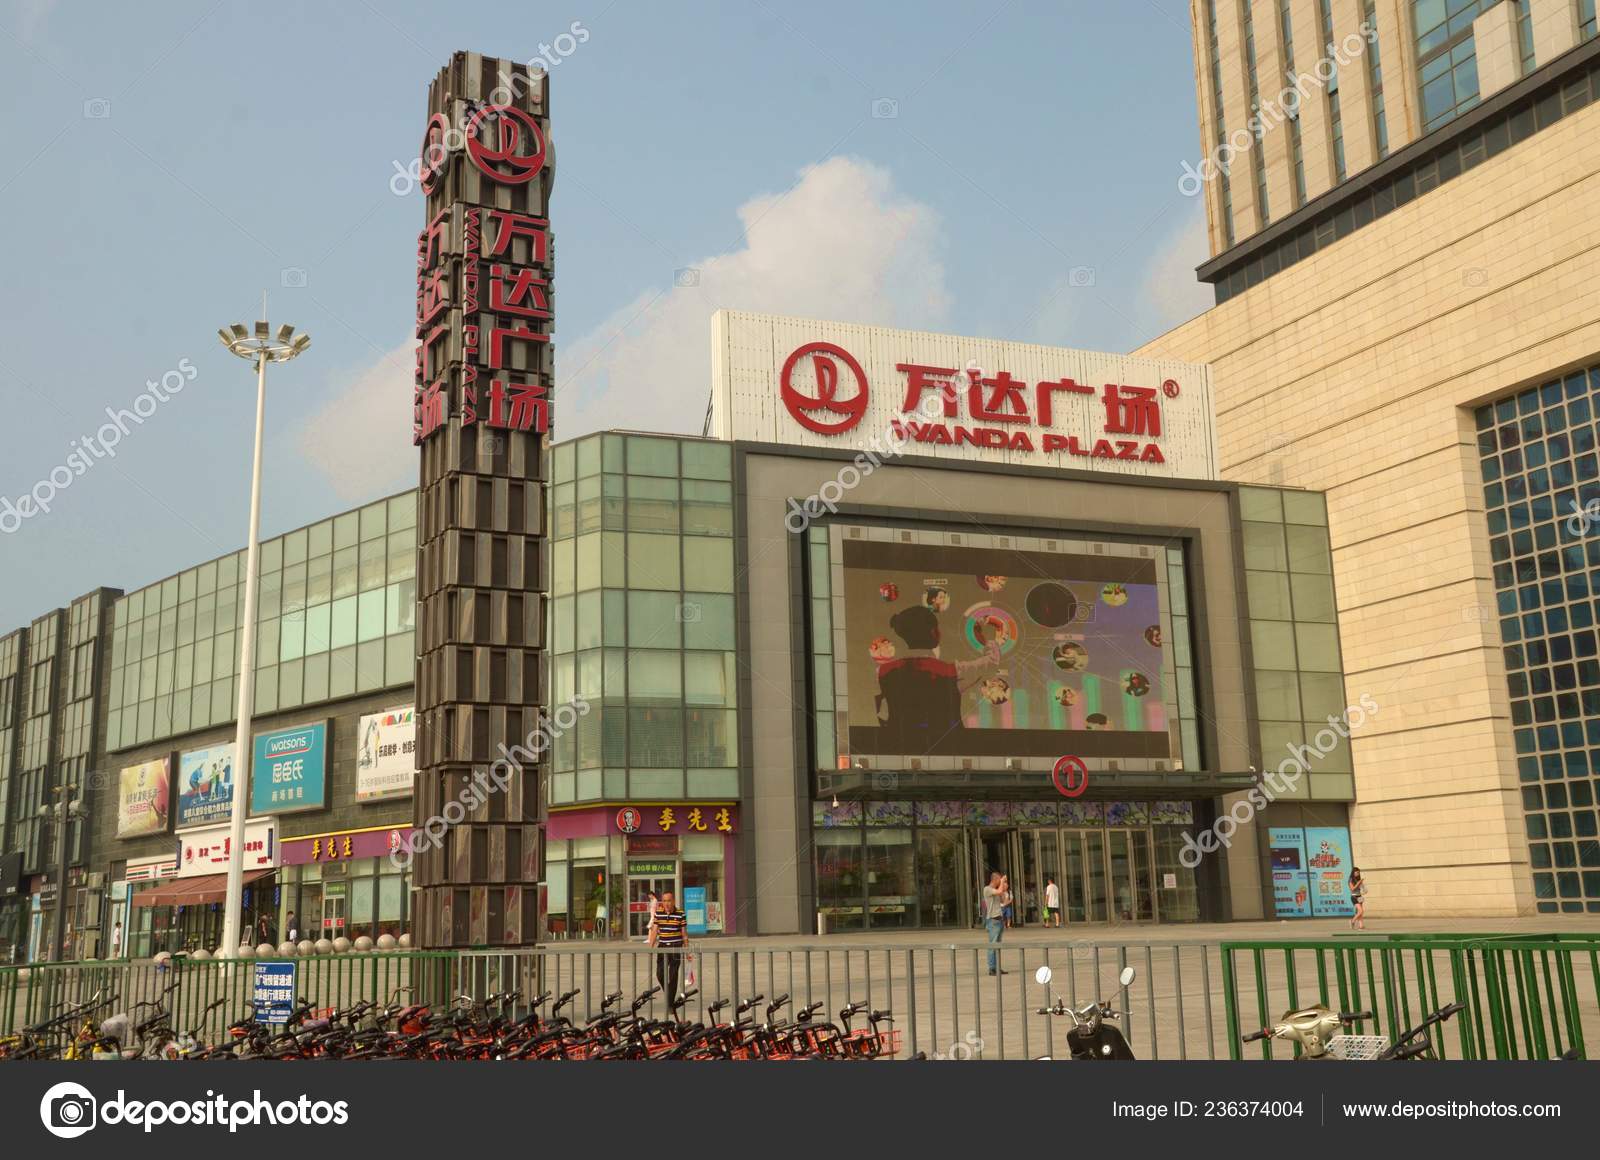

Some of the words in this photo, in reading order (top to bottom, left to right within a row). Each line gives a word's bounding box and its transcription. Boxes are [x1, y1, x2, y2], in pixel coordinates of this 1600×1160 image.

[463, 207, 481, 316] WANDA
[486, 210, 551, 434] 万达广场
[461, 325, 480, 428] PLAZA
[895, 362, 1162, 438] 万达广场
[892, 420, 1034, 452] WANDA
[1042, 433, 1165, 464] PLAZA
[271, 736, 307, 752] watsons
[272, 759, 304, 783] 屈臣氏
[657, 807, 733, 832] 李先生
[311, 836, 352, 860] 李先生
